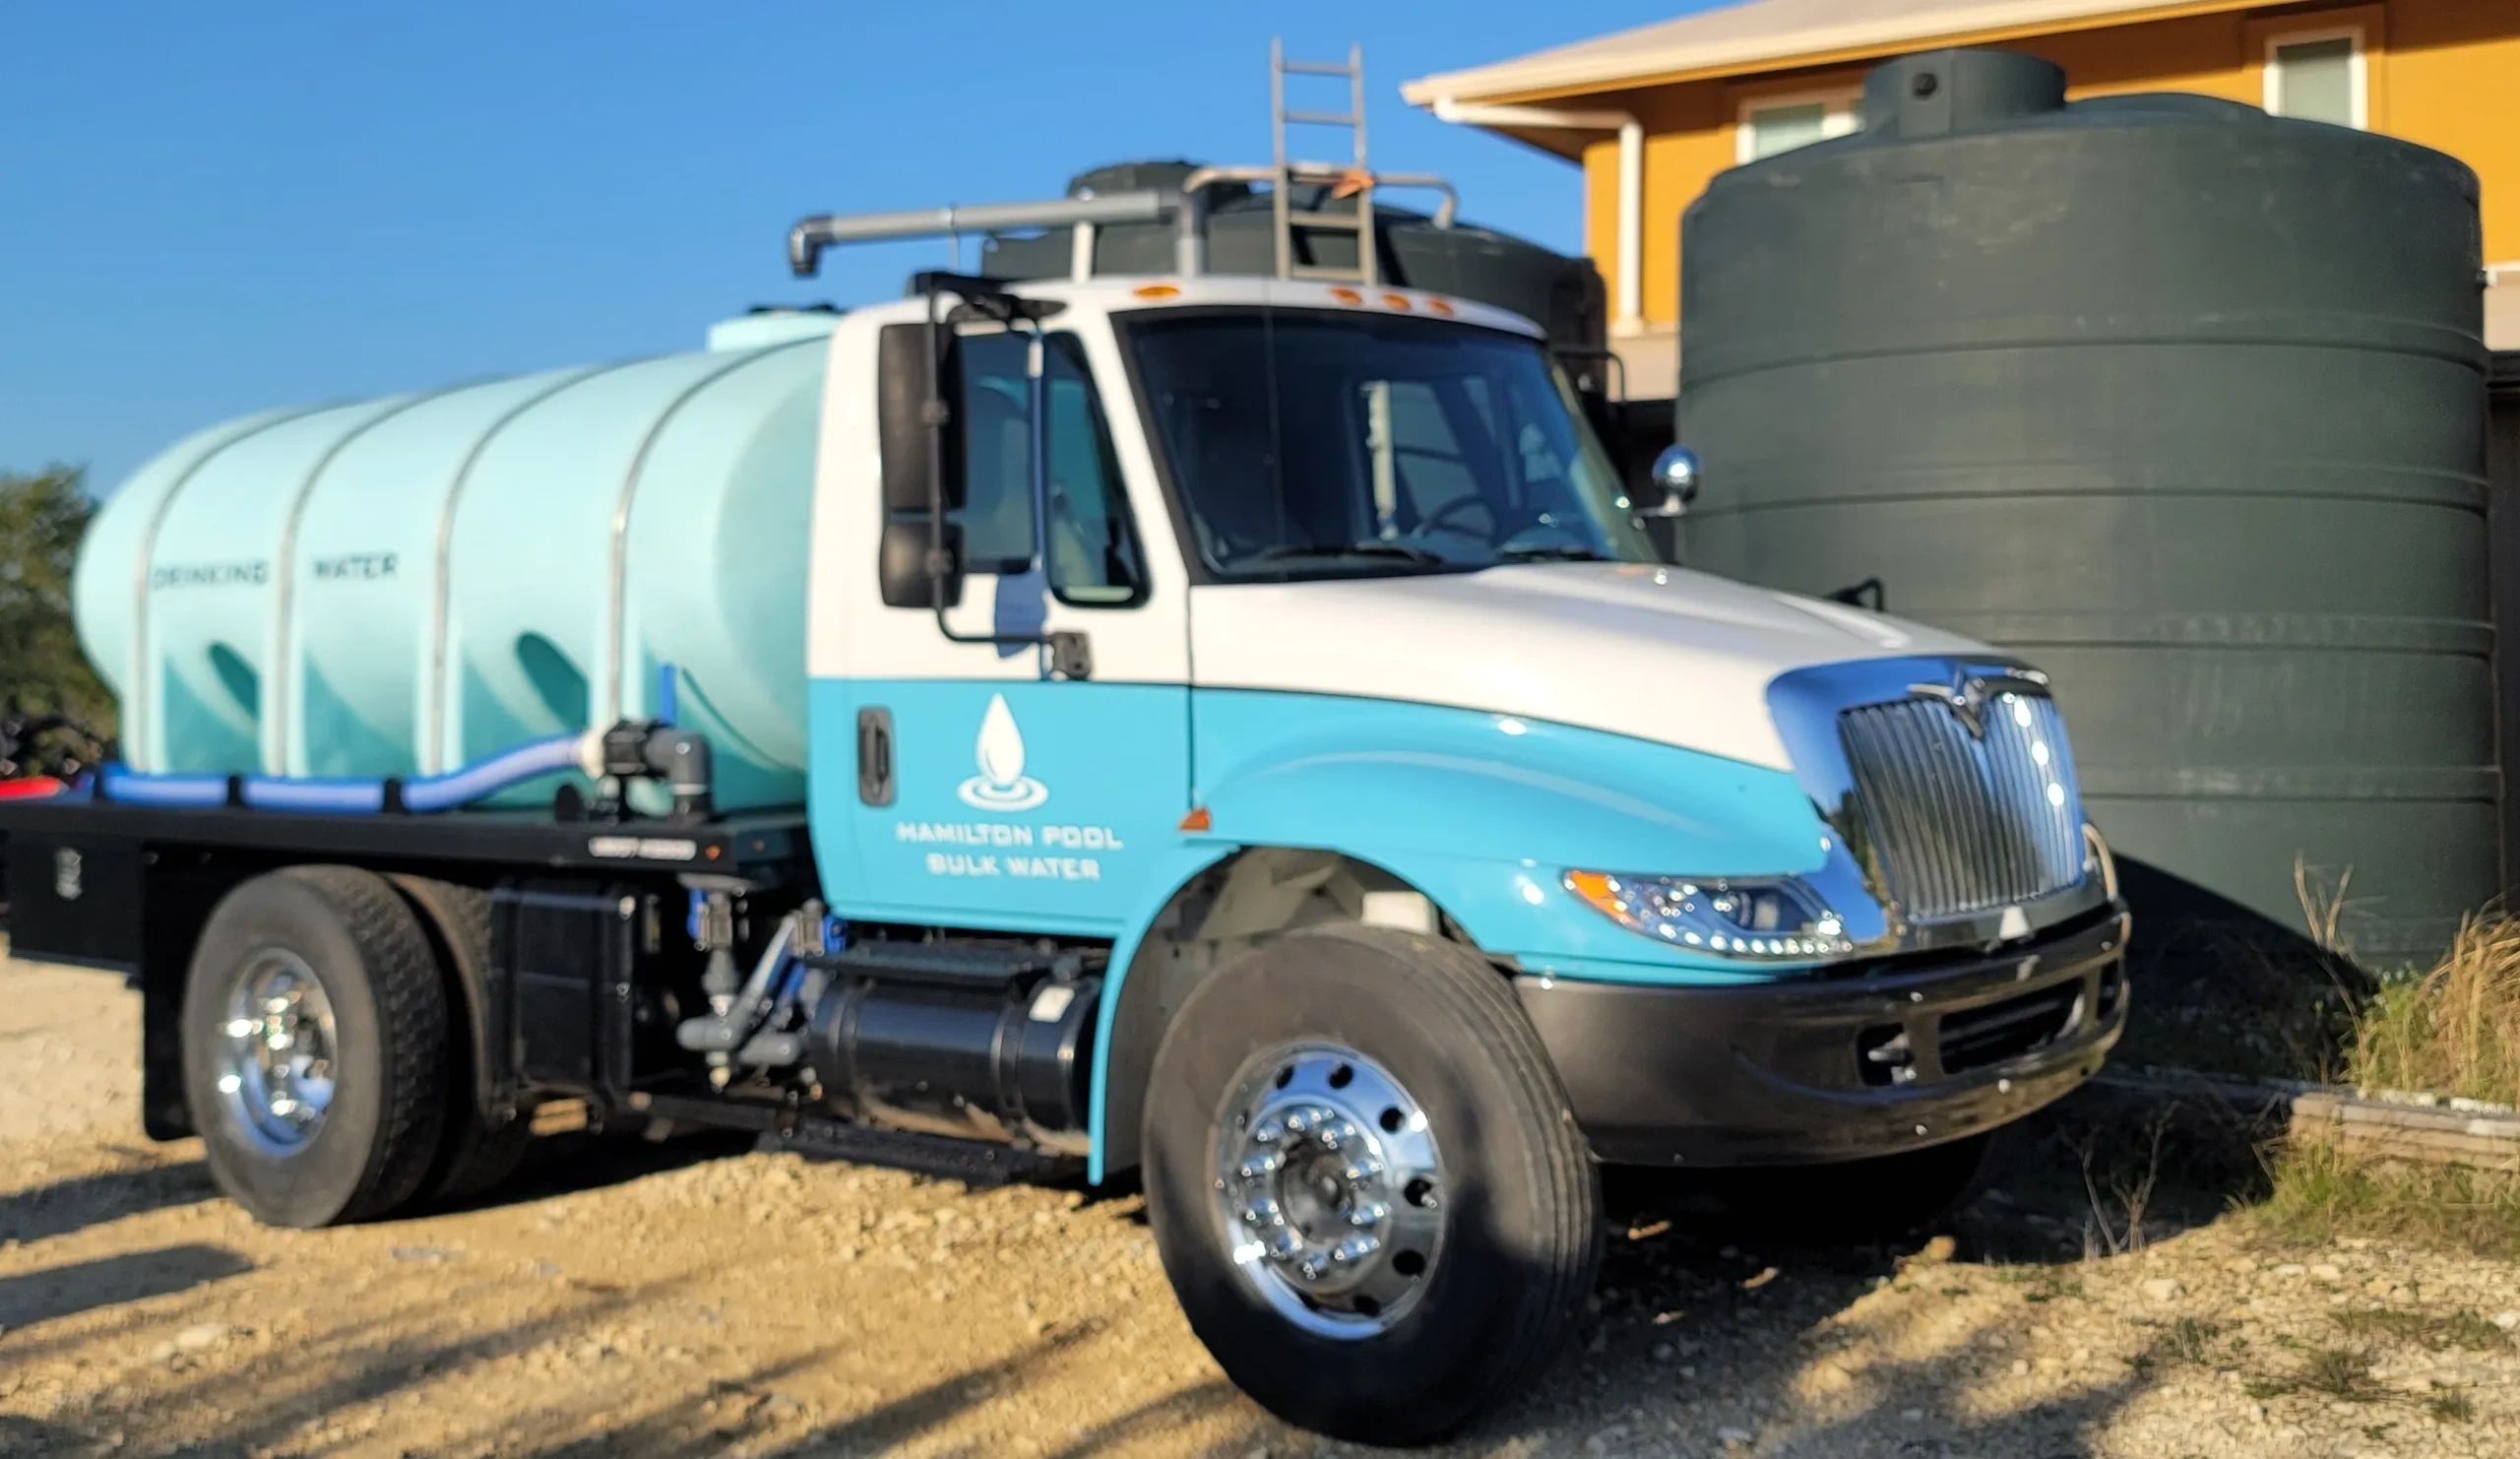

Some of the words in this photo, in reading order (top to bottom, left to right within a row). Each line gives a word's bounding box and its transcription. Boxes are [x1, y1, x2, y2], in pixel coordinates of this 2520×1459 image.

[154, 562, 268, 590] DRINKING
[314, 552, 398, 579] WATER
[897, 822, 1034, 846] HAMILTON
[1042, 826, 1123, 849] POOL
[926, 854, 1000, 876] BULK
[1008, 857, 1101, 880] WATER
